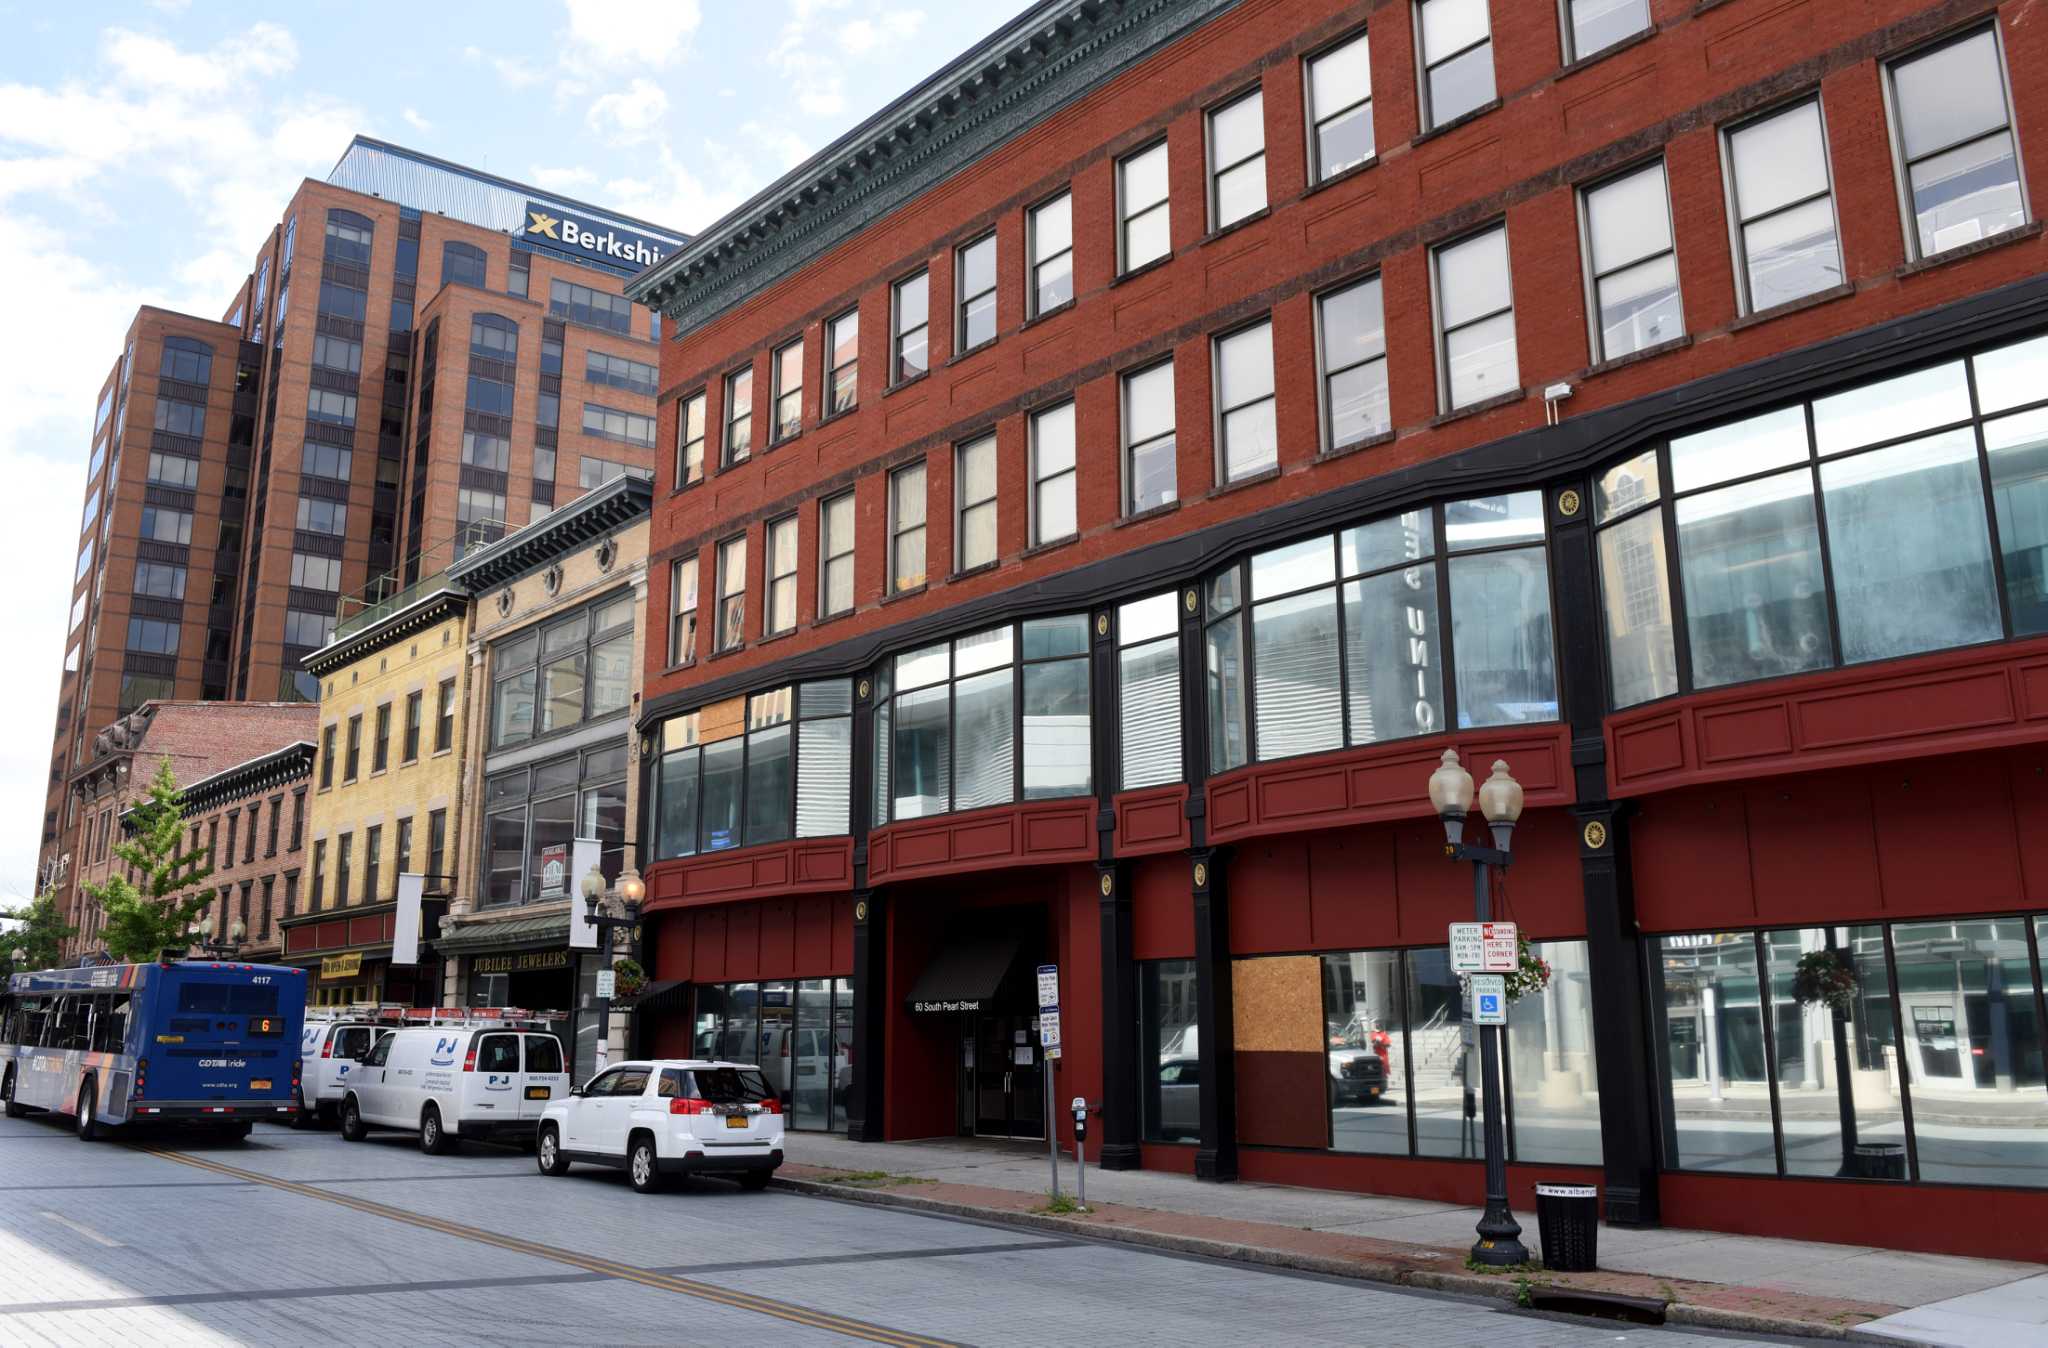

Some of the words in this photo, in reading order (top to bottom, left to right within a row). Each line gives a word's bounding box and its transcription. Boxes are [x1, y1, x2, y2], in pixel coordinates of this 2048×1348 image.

[561, 220, 664, 266] Berkshi
[474, 957, 512, 971] JUBILEE
[517, 951, 567, 969] JEWELERS
[252, 976, 271, 985] 4117
[915, 1002, 923, 1012] 60
[924, 1002, 942, 1012] South
[943, 1001, 959, 1011] Pearl
[960, 1000, 979, 1010] Street
[261, 1018, 270, 1032] 6
